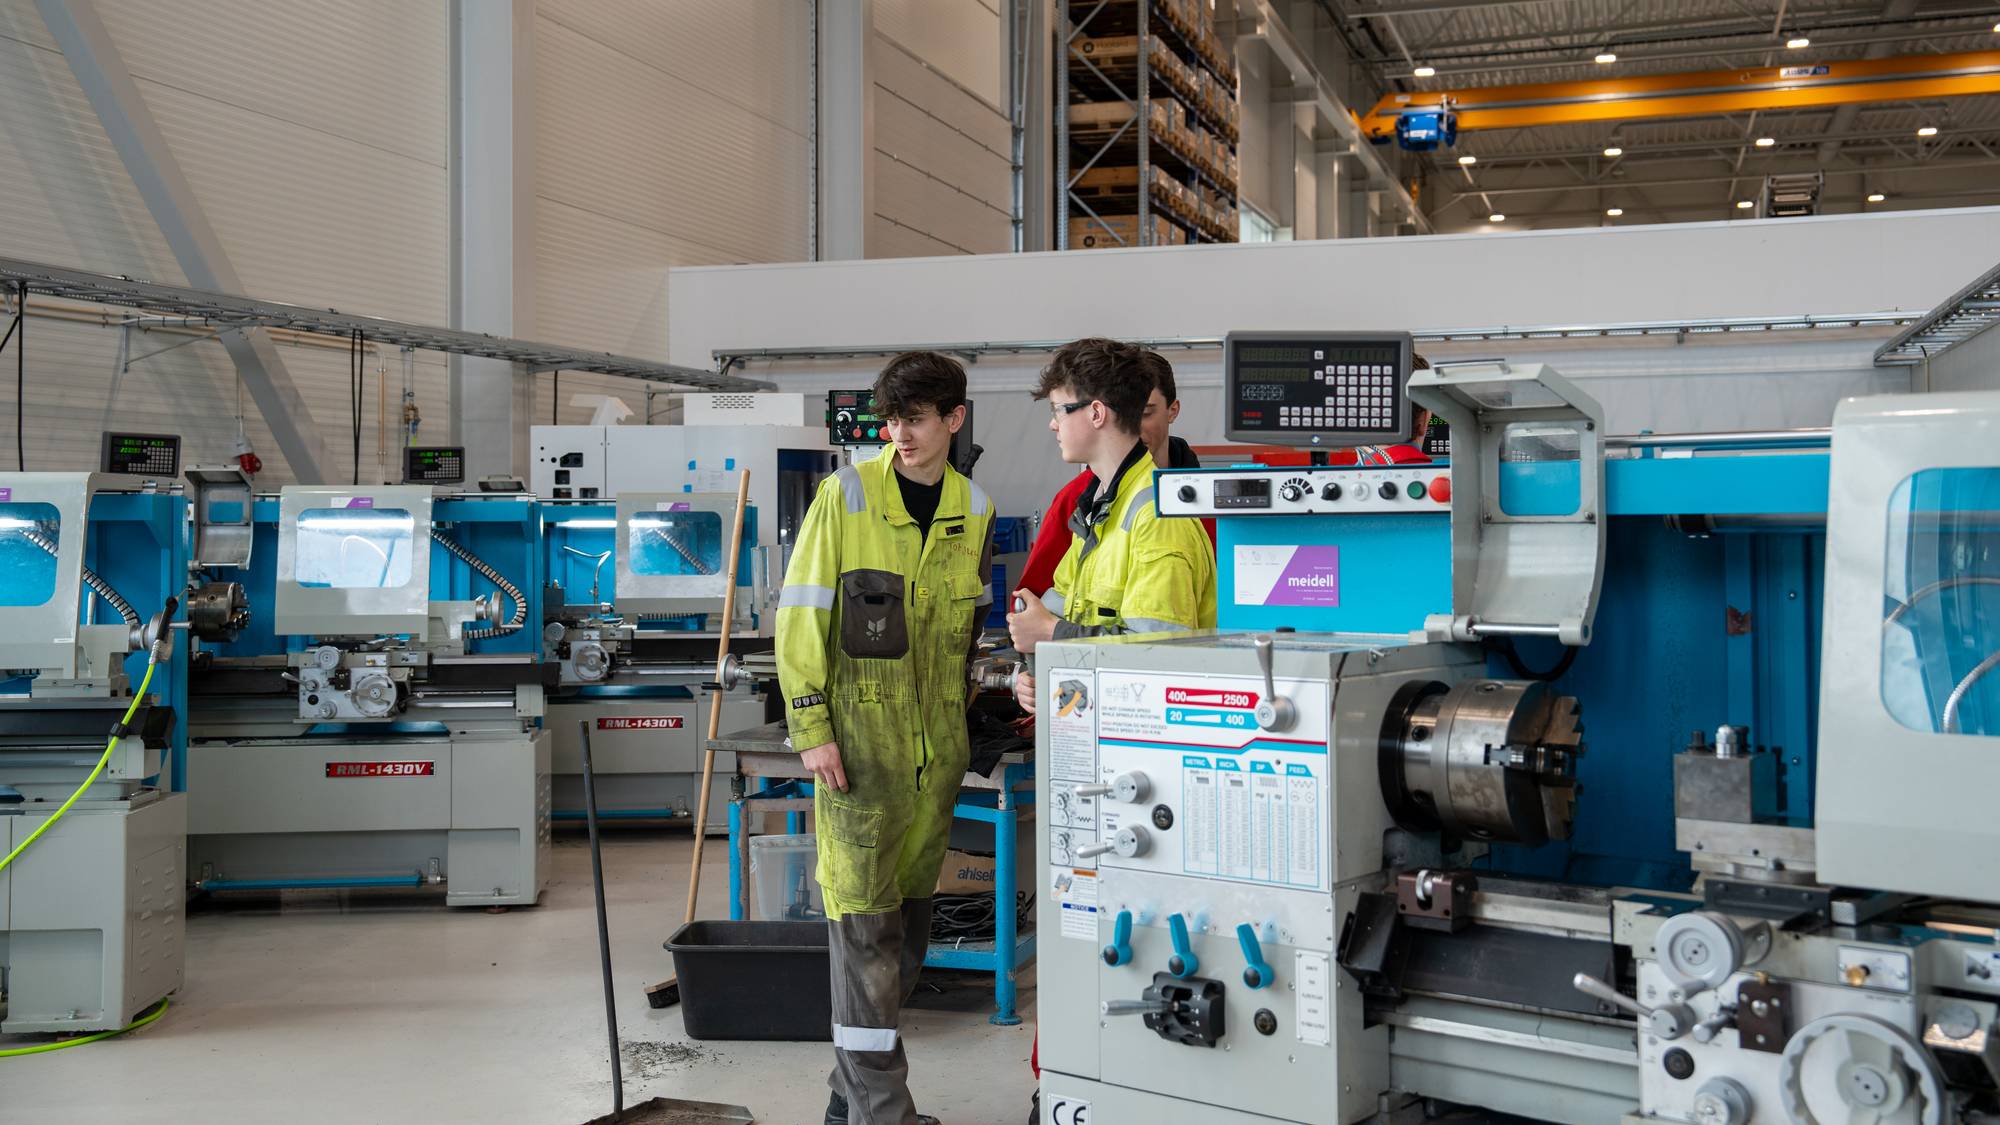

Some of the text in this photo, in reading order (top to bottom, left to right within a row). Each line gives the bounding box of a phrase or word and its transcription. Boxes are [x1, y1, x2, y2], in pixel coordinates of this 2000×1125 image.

[1288, 573, 1334, 587] meidell
[1168, 691, 1186, 702] 400
[1223, 694, 1249, 706] 2500
[1170, 710, 1182, 721] 20
[1225, 714, 1245, 726] 400
[605, 719, 676, 728] RML-1430V
[337, 764, 425, 775] RML-1430V
[958, 866, 996, 881] ahlsell
[1053, 1101, 1086, 1125] CE
